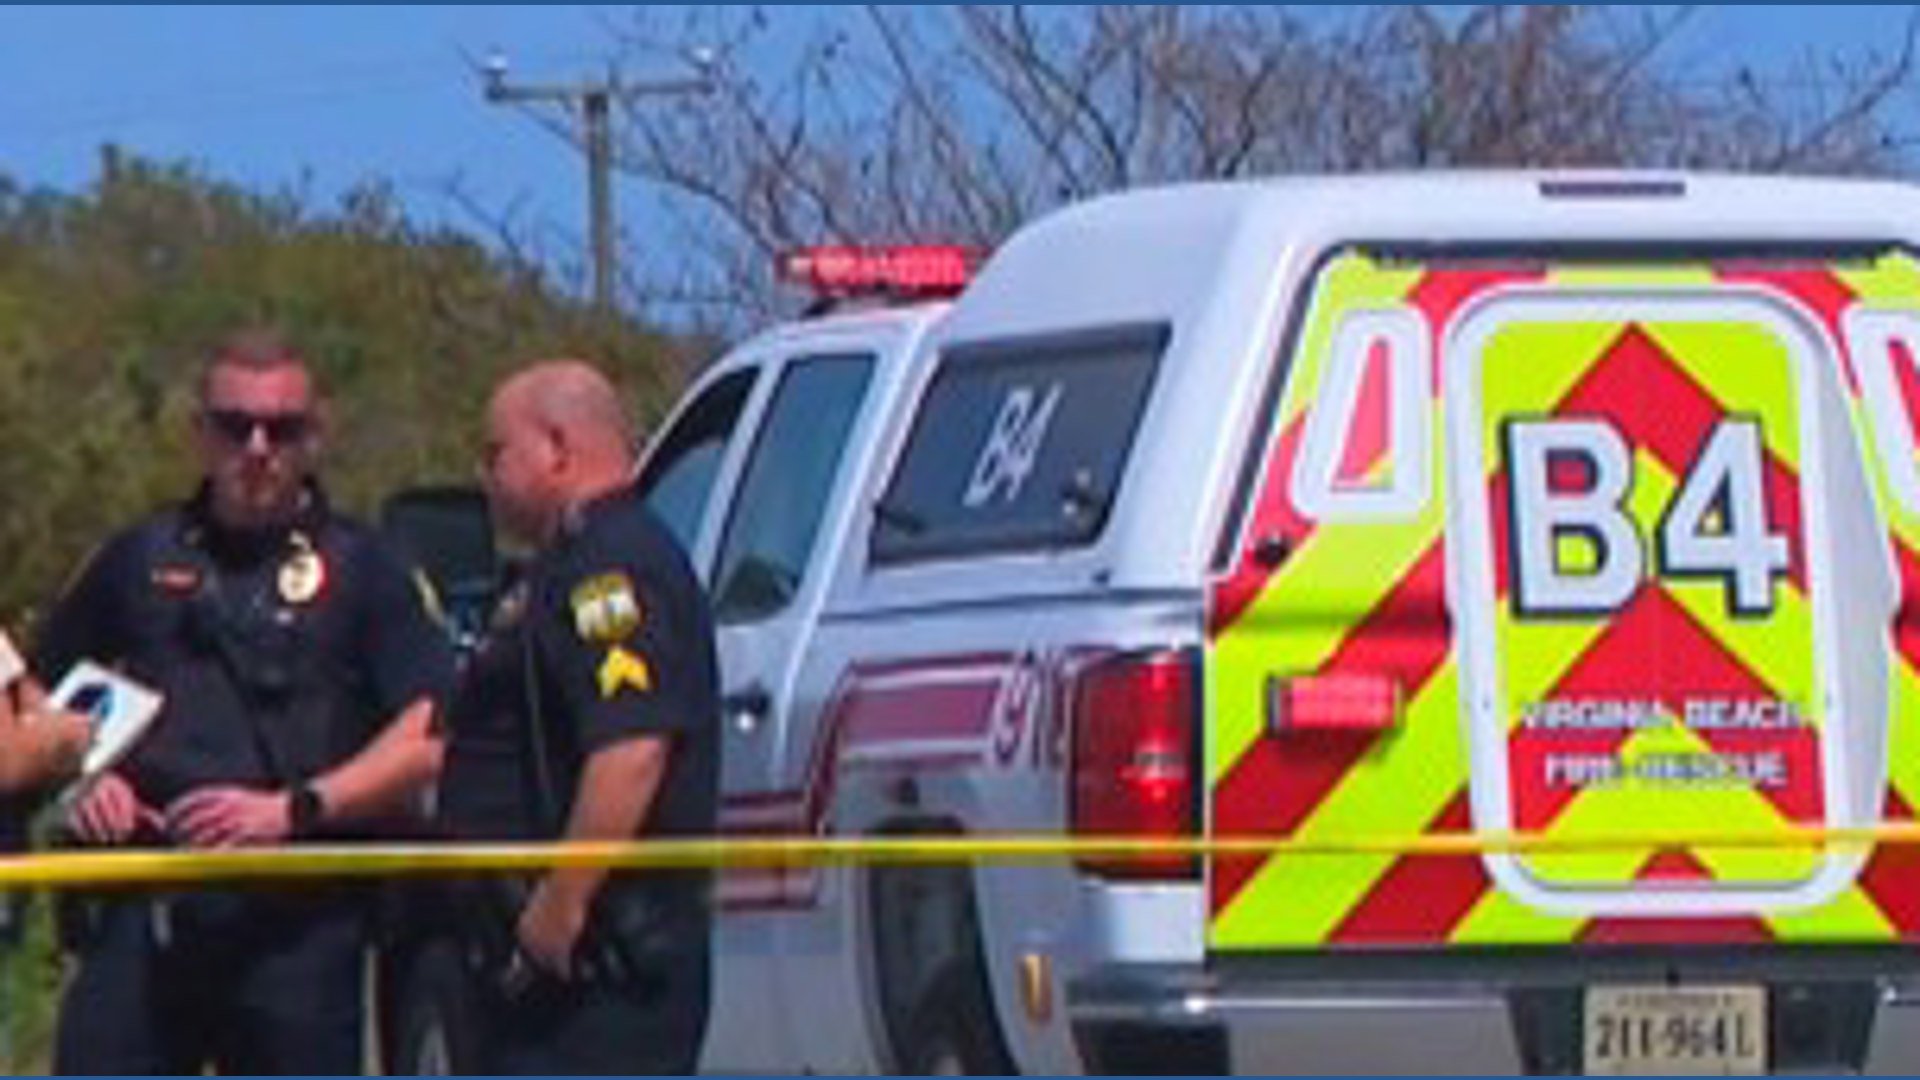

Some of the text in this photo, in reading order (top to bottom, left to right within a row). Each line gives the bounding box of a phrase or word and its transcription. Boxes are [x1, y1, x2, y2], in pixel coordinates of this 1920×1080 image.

[962, 384, 1064, 507] B4
[1499, 412, 1790, 620] B4
[1521, 700, 1801, 729] VIRGINIA BEACH
